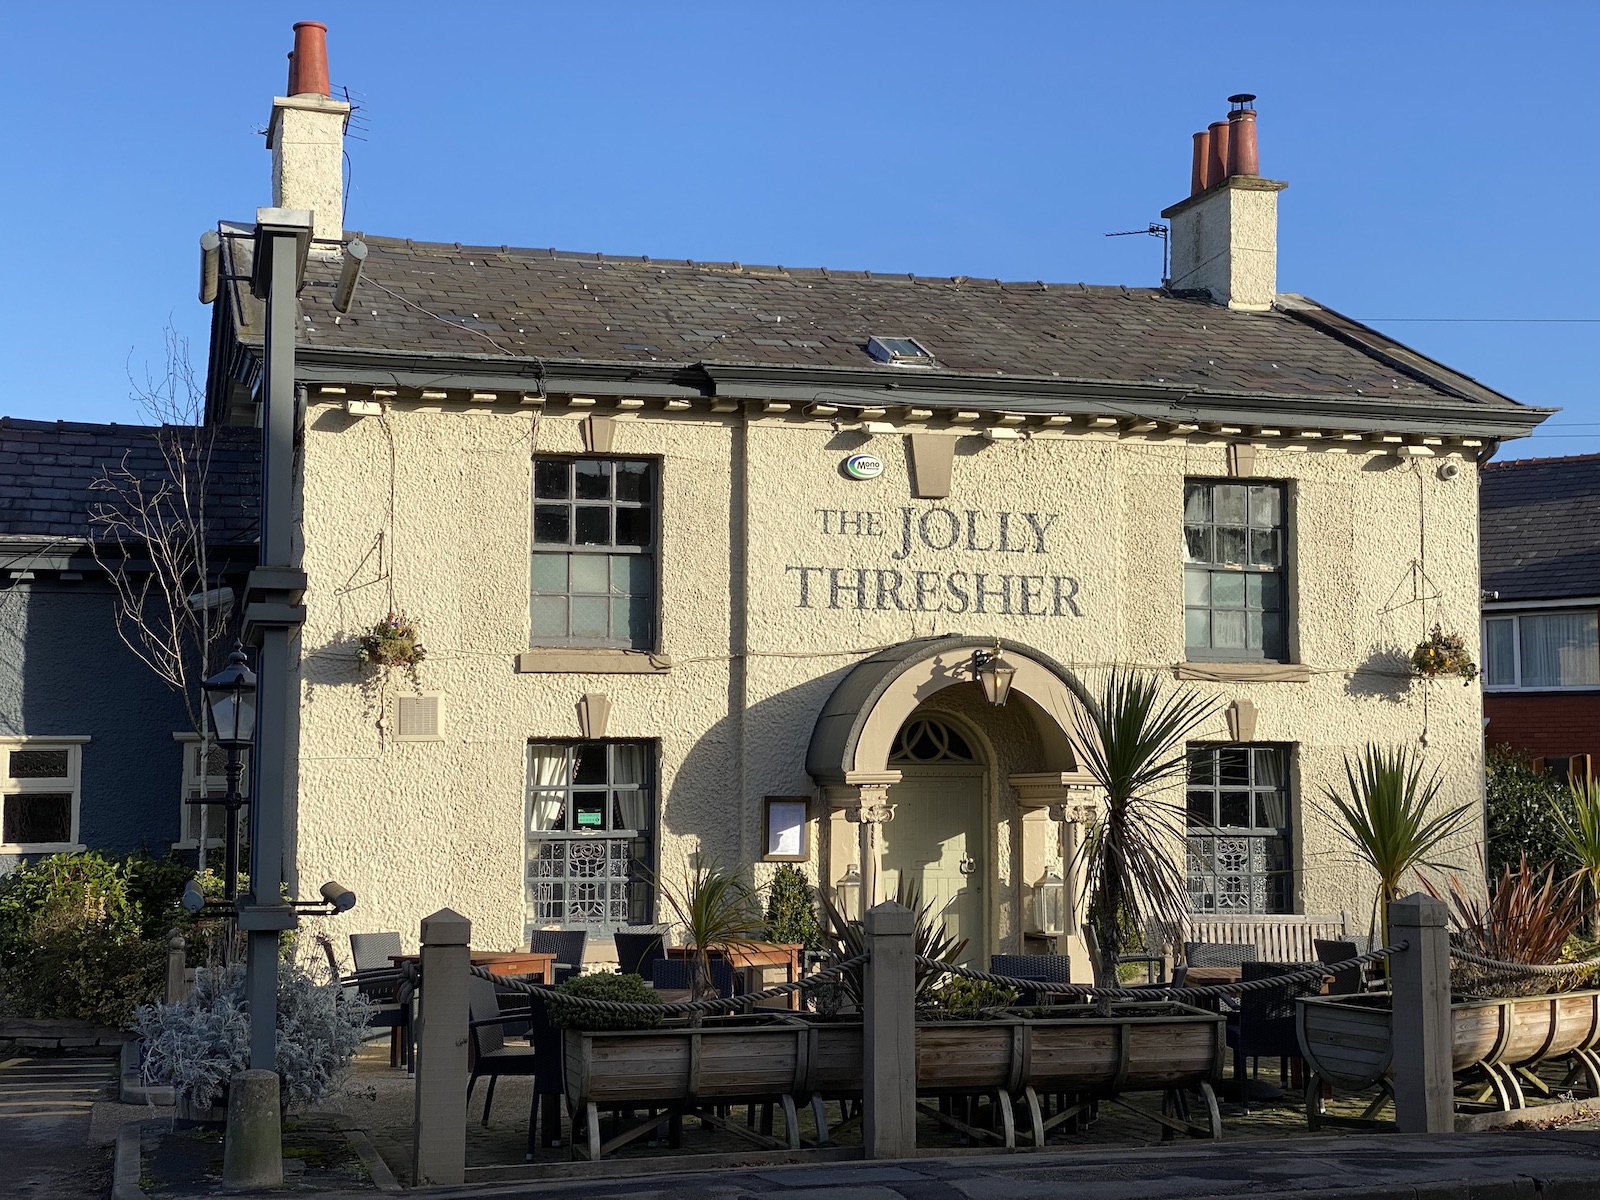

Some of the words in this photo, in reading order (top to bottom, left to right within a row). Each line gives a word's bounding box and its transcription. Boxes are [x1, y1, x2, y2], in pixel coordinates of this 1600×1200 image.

[856, 461, 880, 470] Mono
[814, 508, 882, 537] THE
[891, 506, 1058, 560] JOLLY
[785, 563, 1085, 617] THRESHER
